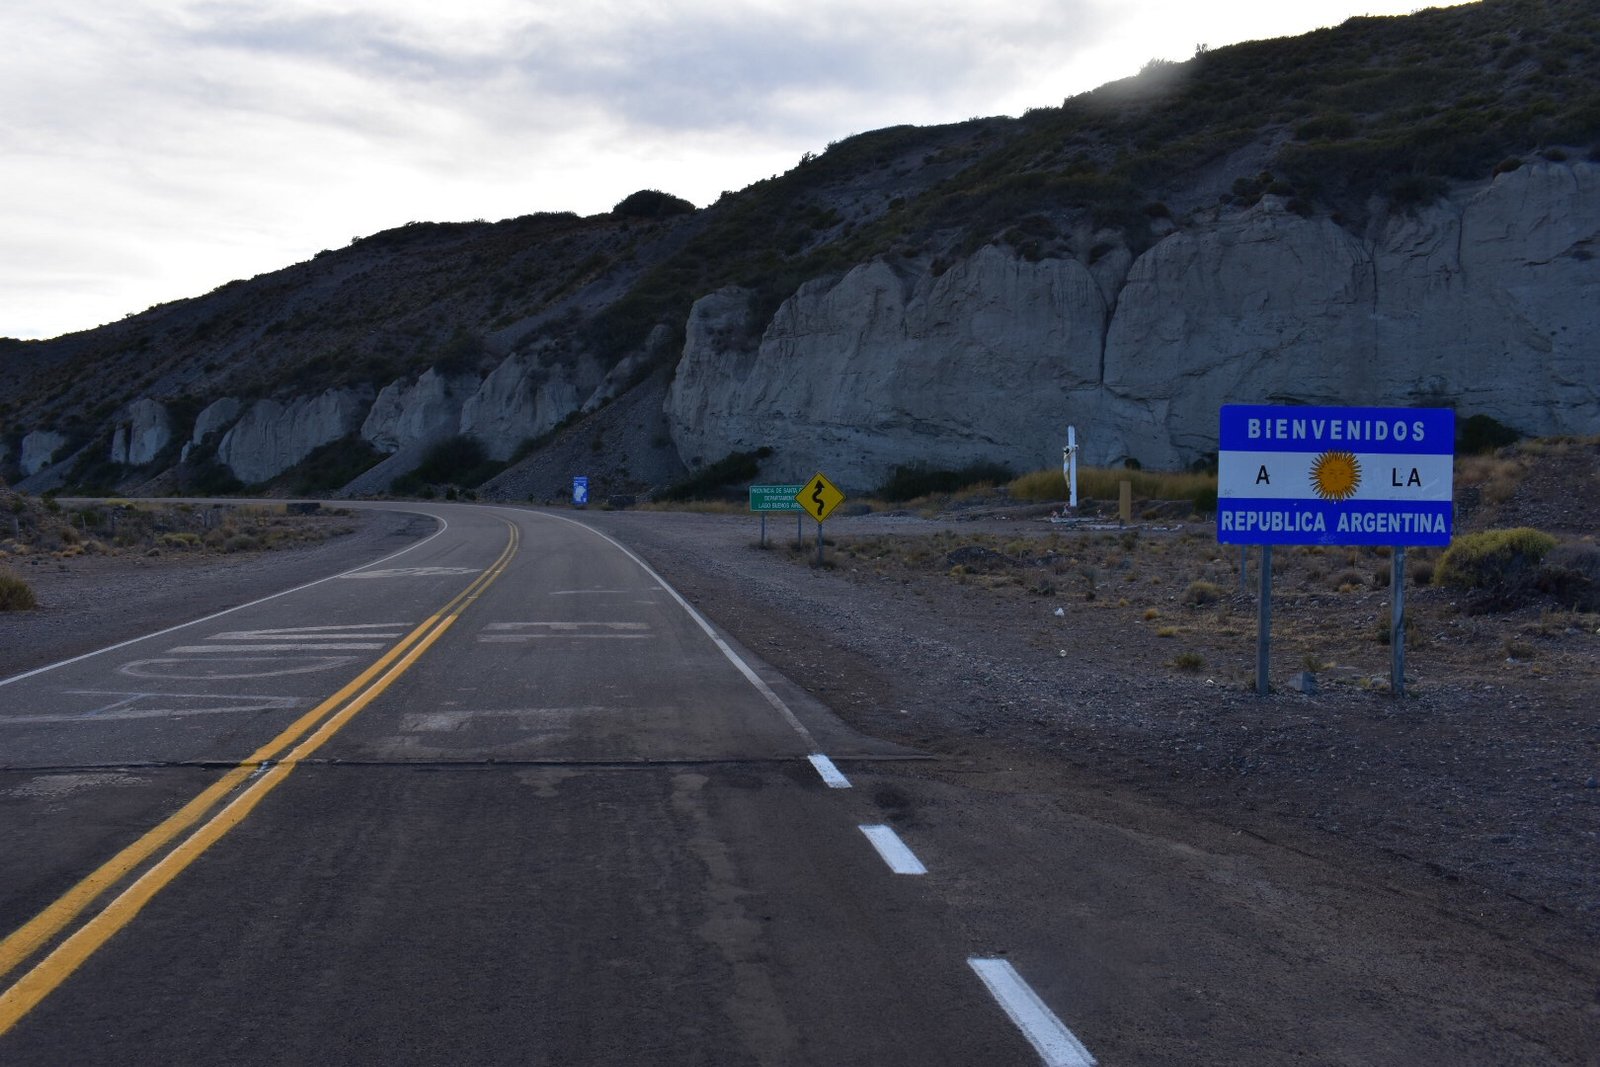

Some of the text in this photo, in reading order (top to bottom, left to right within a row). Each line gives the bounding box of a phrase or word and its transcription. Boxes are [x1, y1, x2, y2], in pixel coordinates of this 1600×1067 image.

[1247, 418, 1425, 442] BIENVENIDOS
[1255, 464, 1421, 487] A LA
[1221, 510, 1446, 533] REPUBLICA ARGENTINA
